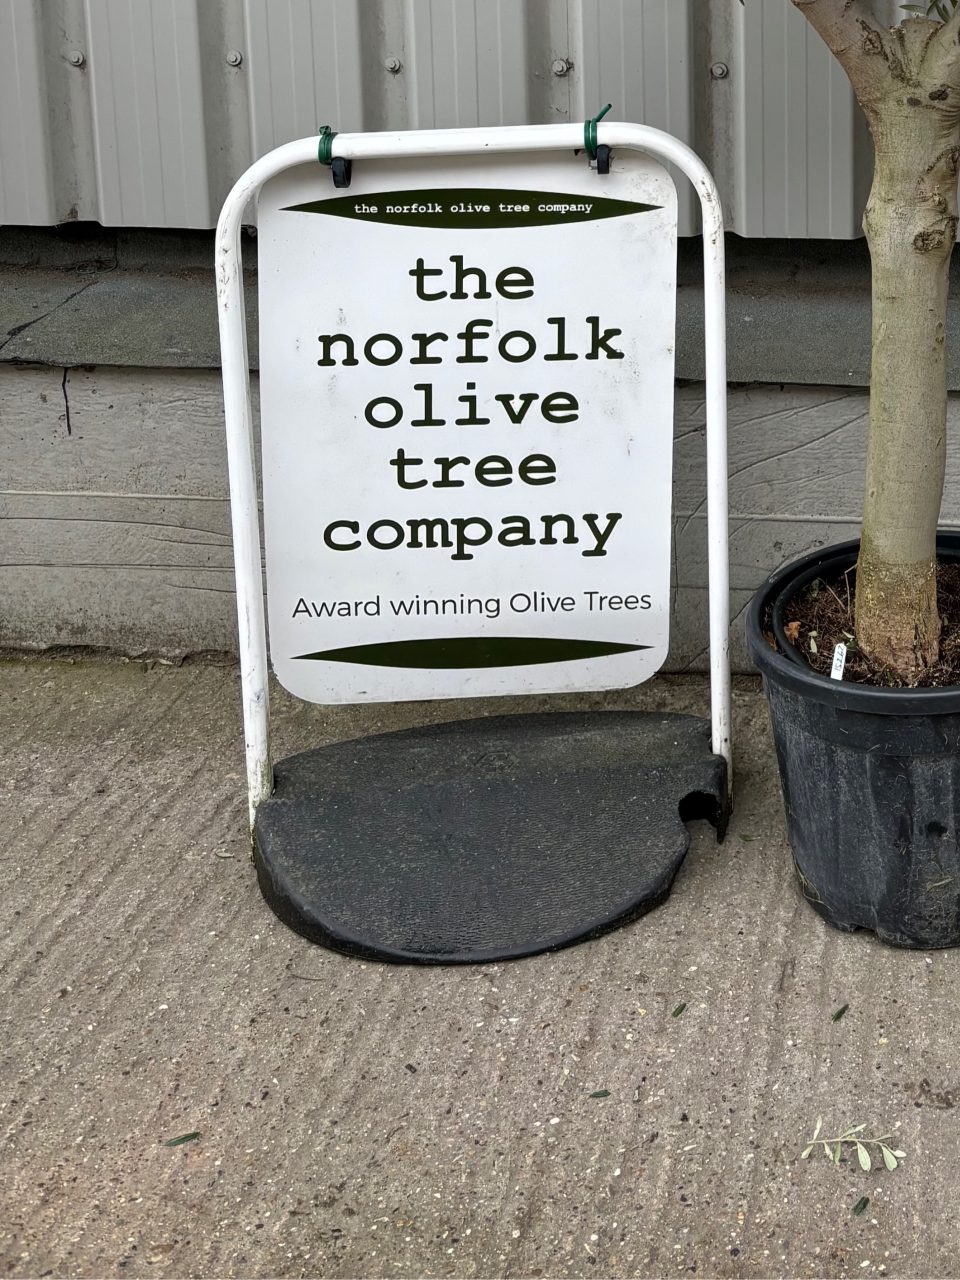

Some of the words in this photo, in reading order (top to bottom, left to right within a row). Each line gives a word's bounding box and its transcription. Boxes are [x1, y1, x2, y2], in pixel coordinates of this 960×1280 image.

[354, 203, 379, 214] the
[385, 203, 443, 214] norfolk
[450, 202, 491, 213] olive
[498, 202, 530, 213] tree
[537, 202, 593, 217] company
[408, 255, 535, 302] the
[317, 316, 625, 367] norfolk
[364, 382, 579, 429] olive
[389, 448, 557, 490] tree
[323, 513, 623, 561] company
[292, 594, 381, 619] Award
[390, 594, 501, 619] winning
[509, 591, 576, 613] Olive
[583, 590, 652, 612] Trees
